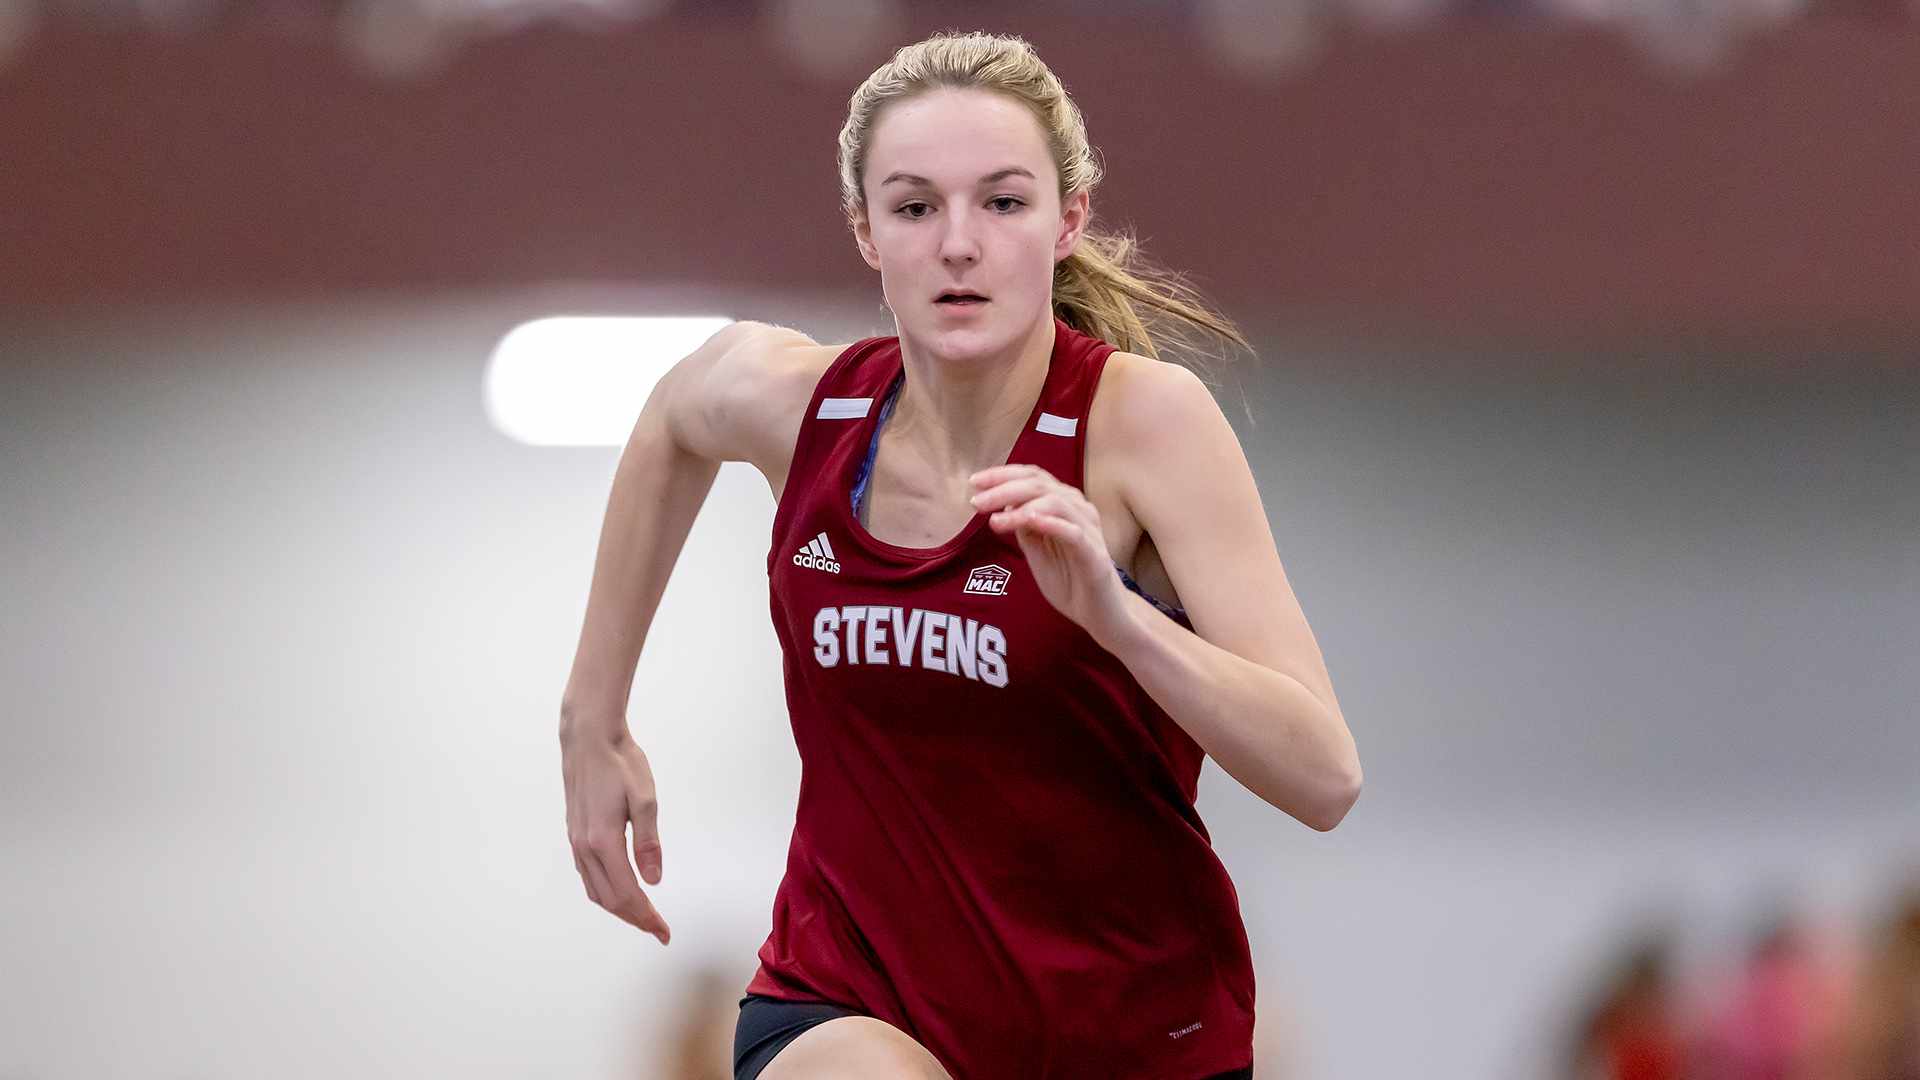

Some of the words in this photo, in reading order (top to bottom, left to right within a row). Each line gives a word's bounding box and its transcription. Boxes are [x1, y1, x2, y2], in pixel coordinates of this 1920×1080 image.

[793, 554, 841, 574] adidas
[968, 578, 1004, 592] MAC
[813, 606, 1009, 689] STEVENS
